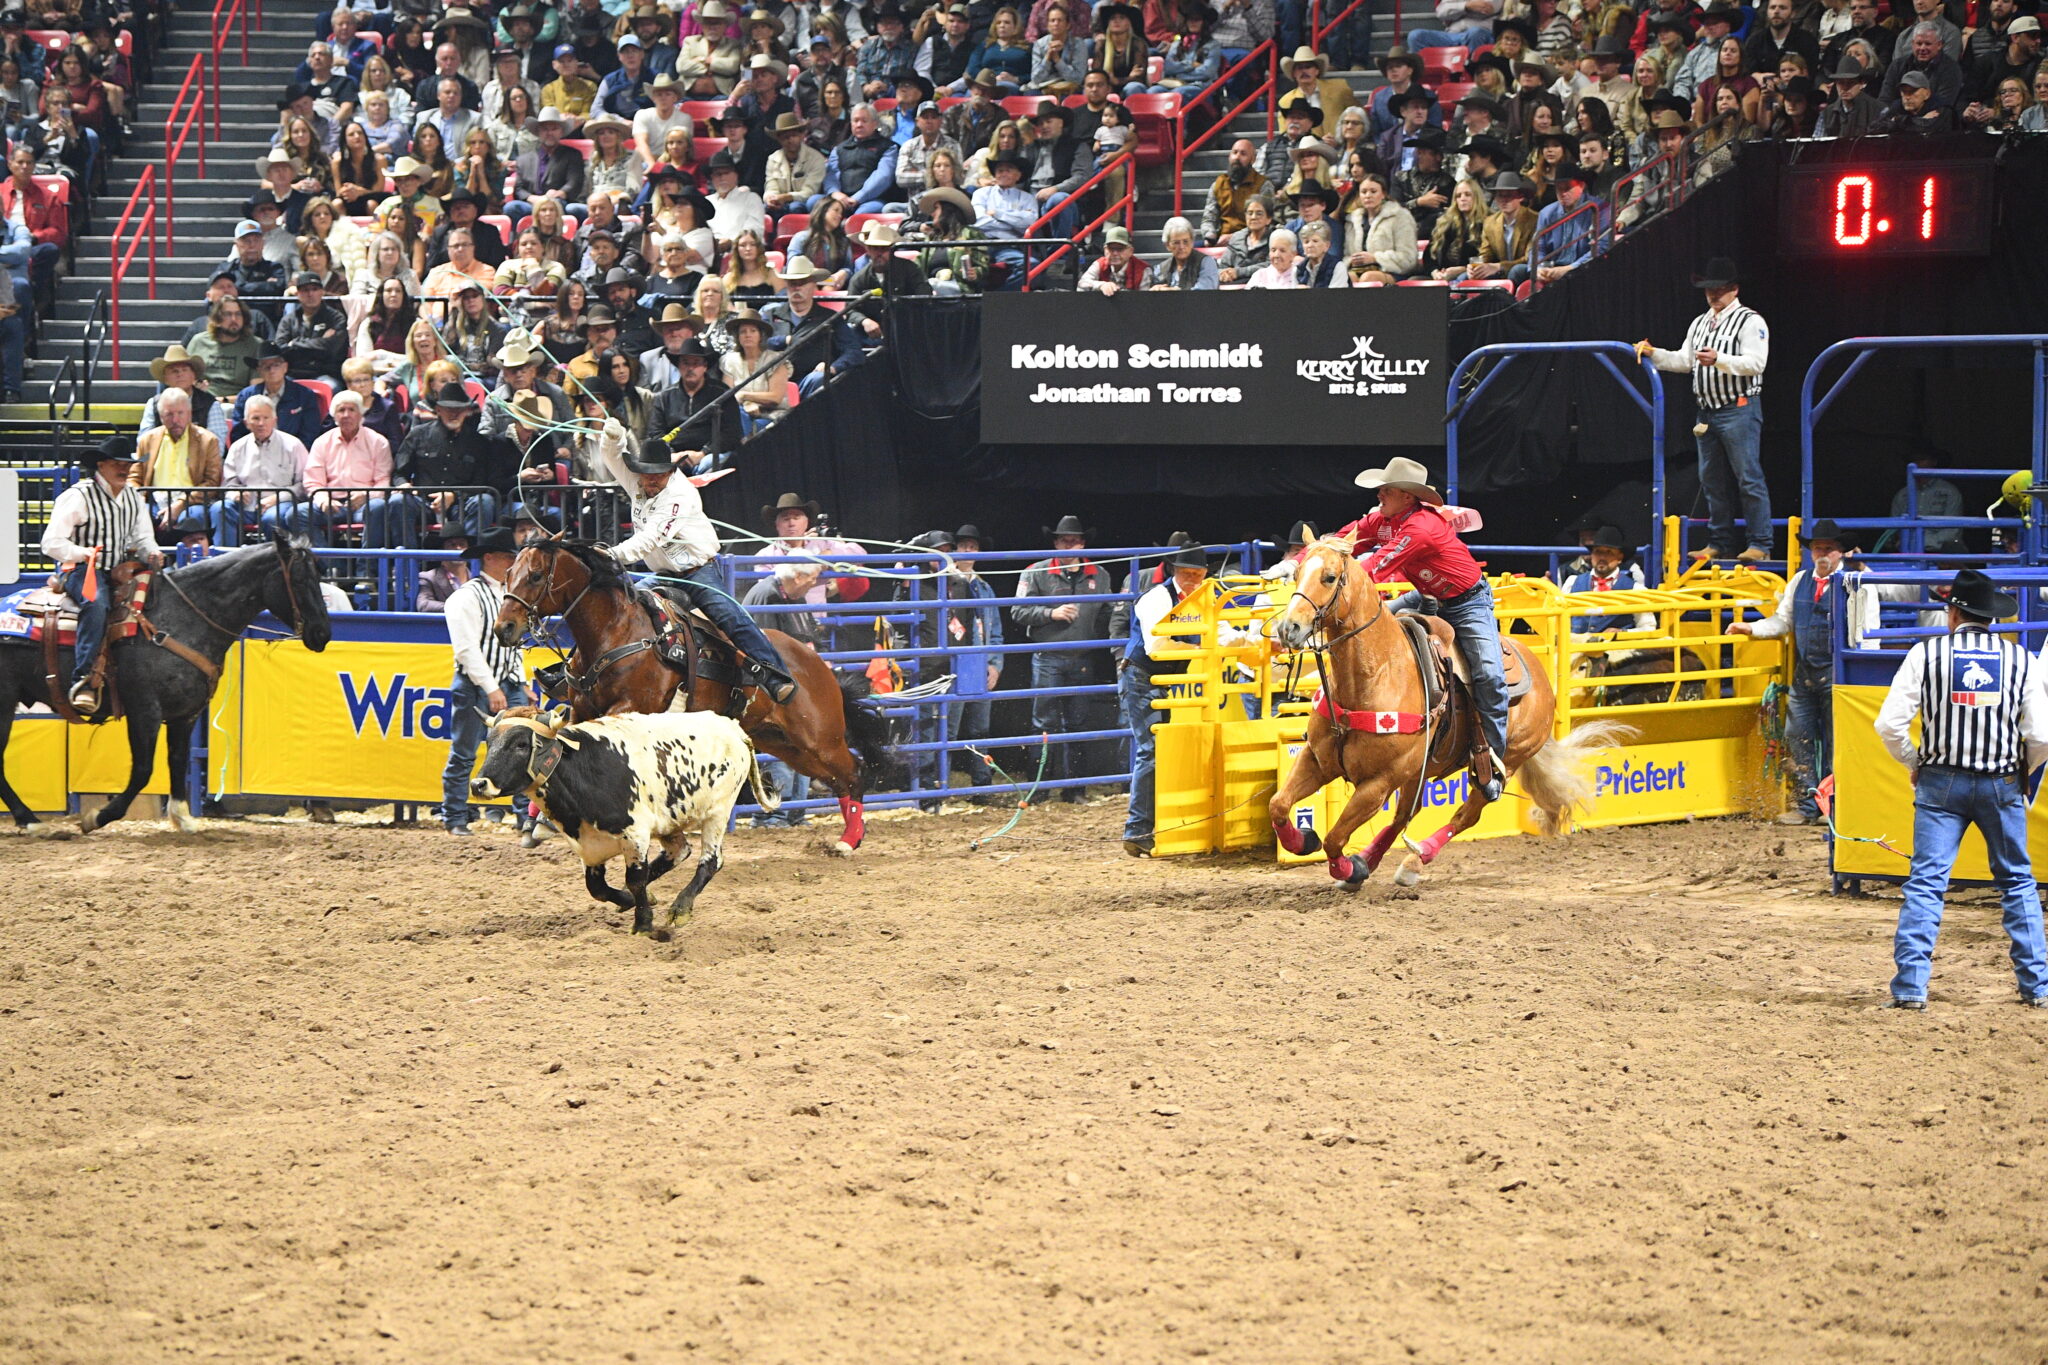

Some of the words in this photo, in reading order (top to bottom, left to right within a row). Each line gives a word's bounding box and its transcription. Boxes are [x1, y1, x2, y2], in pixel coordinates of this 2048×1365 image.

[1011, 344, 1119, 369] Kolton
[1128, 343, 1263, 368] Schmidt
[1297, 359, 1358, 381] KERRY
[1361, 359, 1430, 381] KELLEY
[1029, 383, 1151, 403] Jonathan
[1157, 383, 1242, 402] Torres
[1356, 381, 1369, 396] &
[1595, 759, 1686, 797] Priefert
